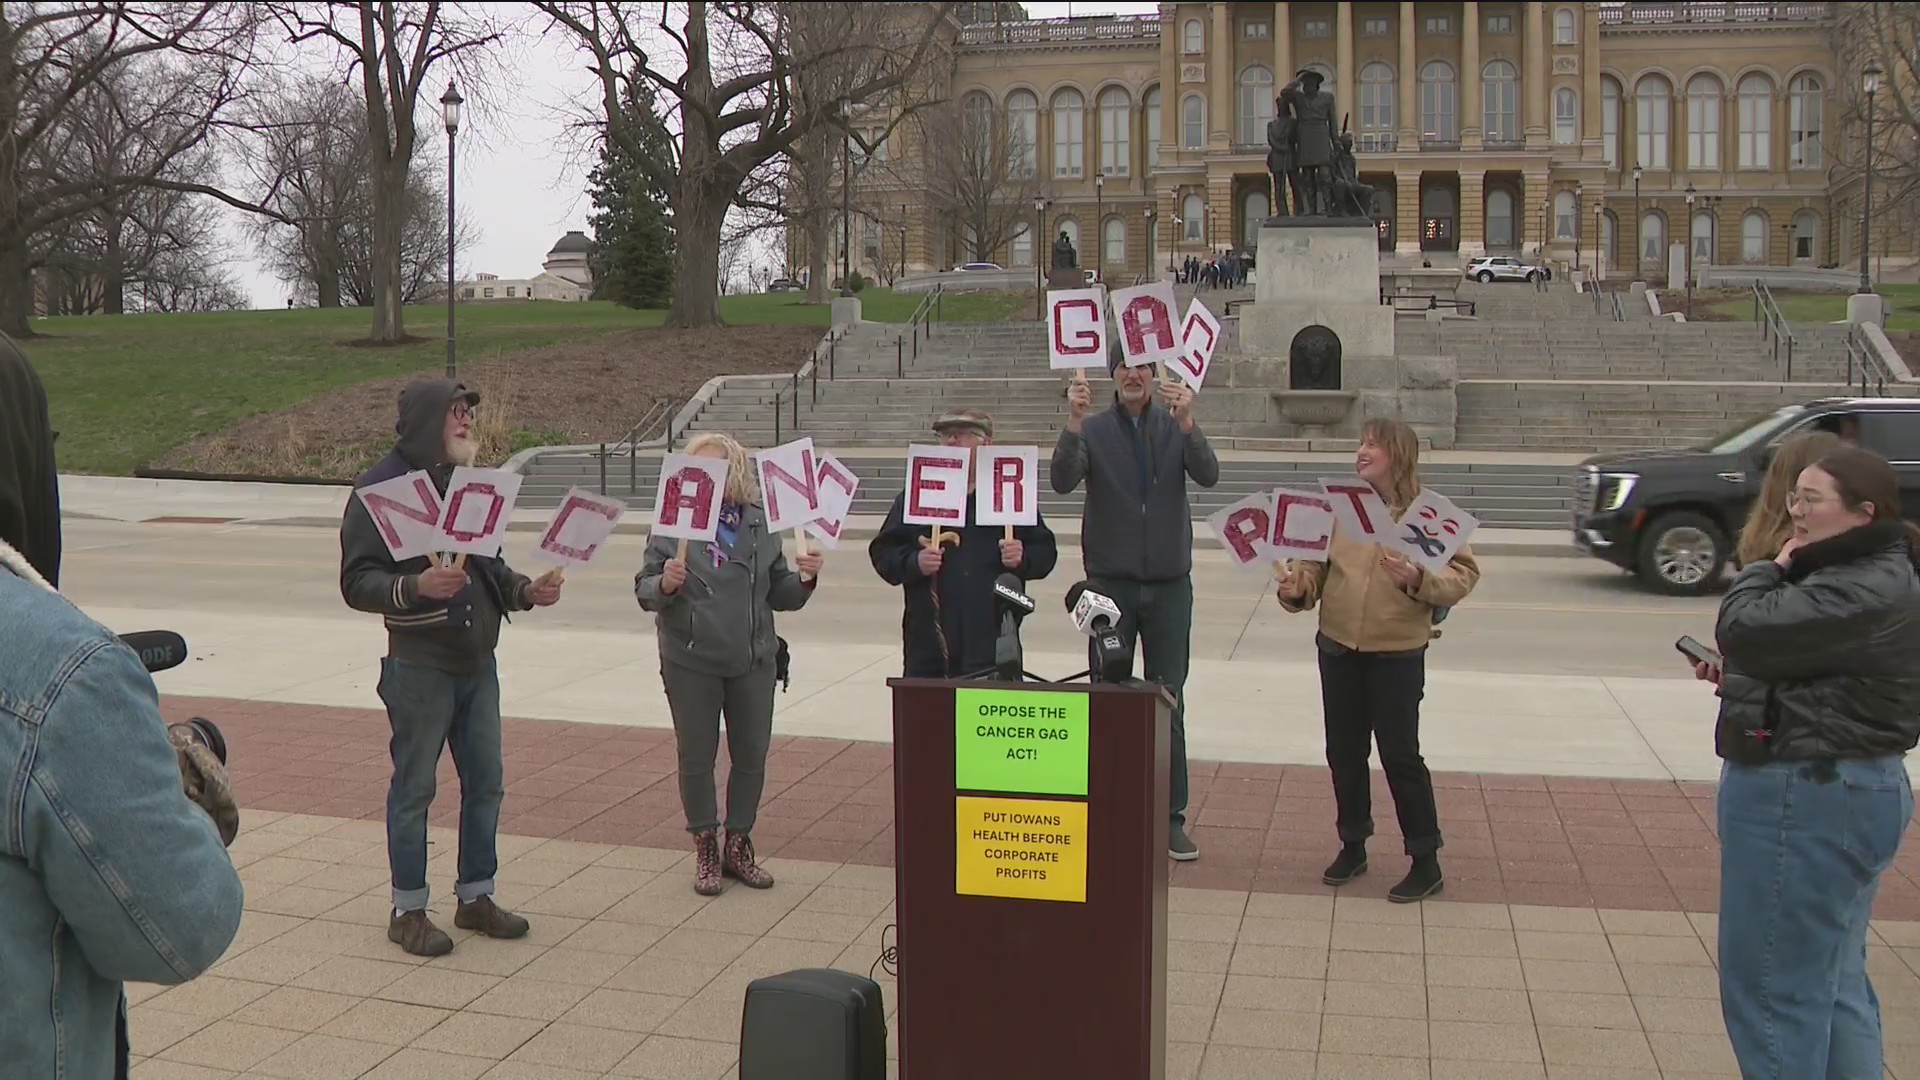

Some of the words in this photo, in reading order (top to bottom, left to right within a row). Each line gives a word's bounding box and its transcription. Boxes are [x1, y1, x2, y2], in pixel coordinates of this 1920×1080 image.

[979, 705, 1036, 718] OPPOSE
[1039, 707, 1066, 719] THE
[976, 726, 1035, 739] CANCER
[1038, 728, 1068, 740] GAG
[1006, 748, 1037, 760] ACT!
[983, 812, 1007, 823] PUT
[1009, 814, 1060, 826] IOWANS
[973, 830, 1019, 842] HEALTH
[1022, 833, 1070, 845] BEFORE
[984, 848, 1059, 862] CORPORATE
[996, 867, 1047, 880] PROFITS
